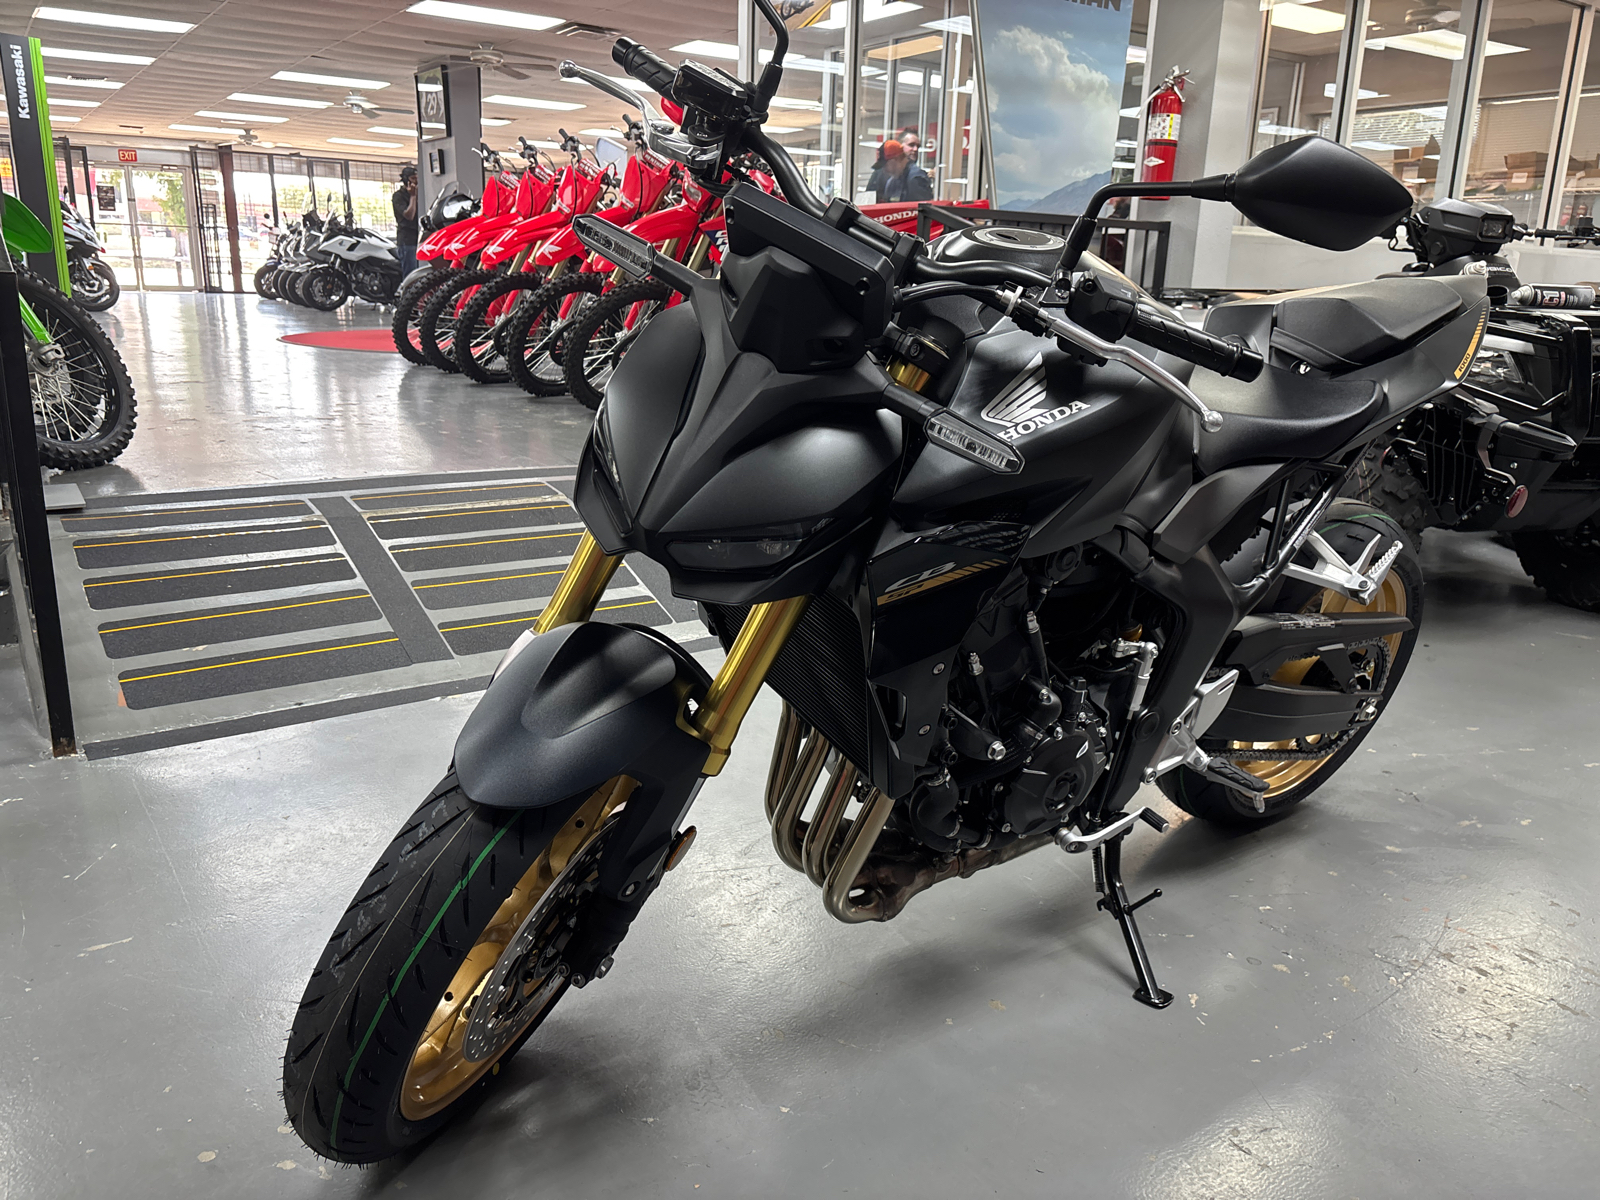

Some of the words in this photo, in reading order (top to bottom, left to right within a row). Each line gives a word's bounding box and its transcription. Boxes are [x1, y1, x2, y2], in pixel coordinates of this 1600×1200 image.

[10, 44, 31, 119] Kawasaki
[120, 151, 135, 160] EXIT
[874, 210, 918, 223] HONDA
[1459, 353, 1471, 372] 1000
[997, 401, 1091, 441] HONDA
[885, 562, 957, 592] CB
[885, 583, 925, 602] SP
